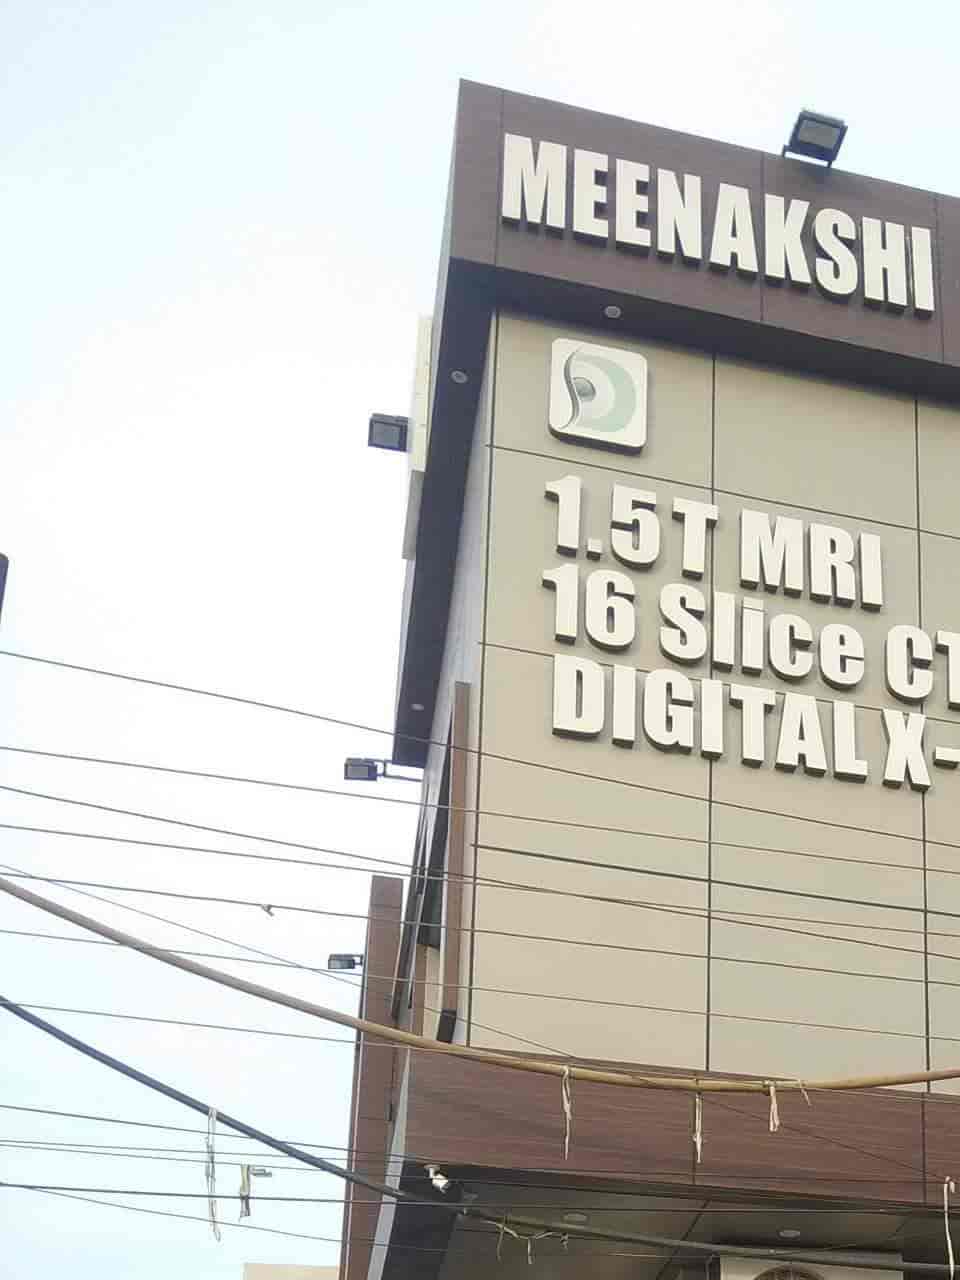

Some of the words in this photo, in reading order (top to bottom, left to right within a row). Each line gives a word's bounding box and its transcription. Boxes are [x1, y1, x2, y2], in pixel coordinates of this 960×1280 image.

[501, 132, 934, 315] MEENAKSHI
[542, 563, 636, 651] 16
[739, 508, 883, 611] MRI
[552, 654, 869, 783] DIGITAL
